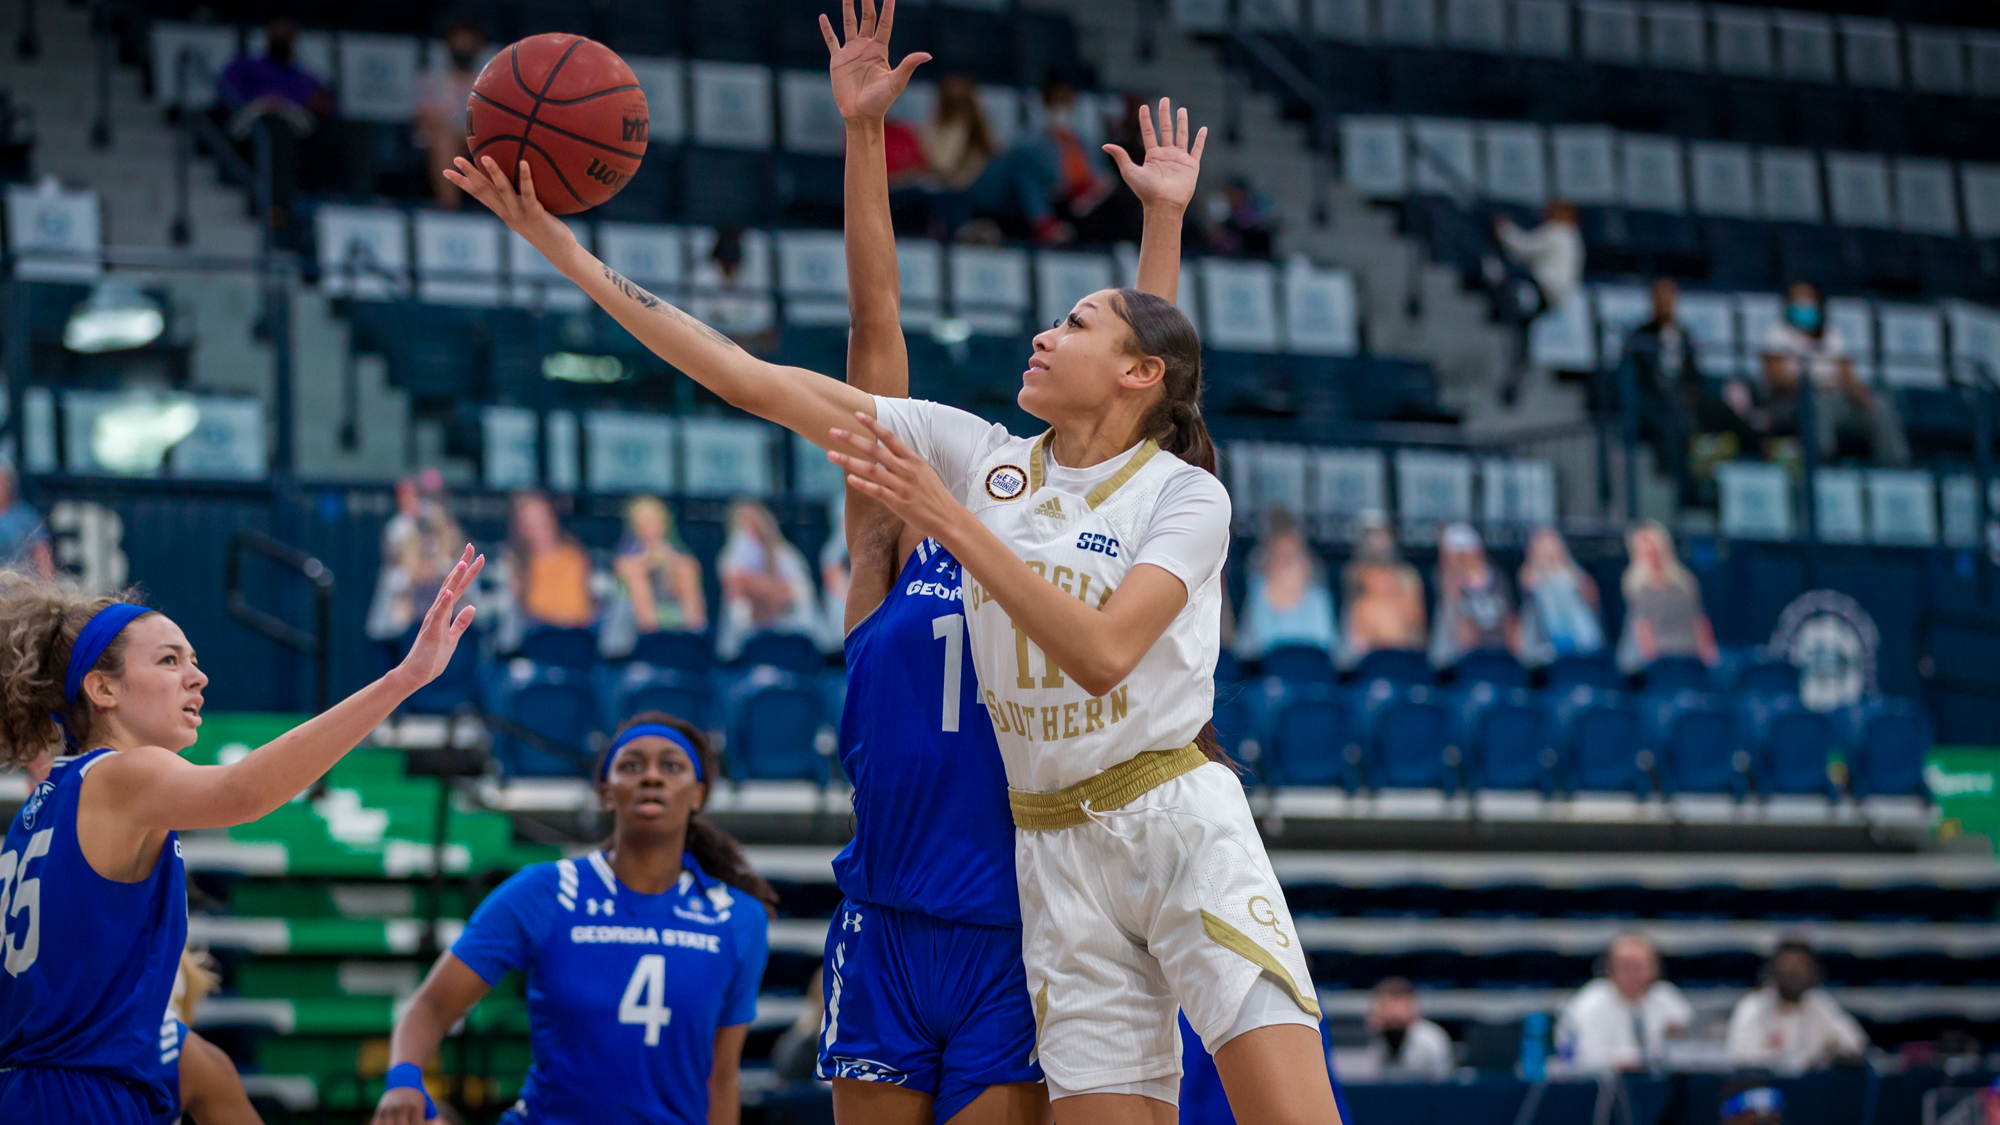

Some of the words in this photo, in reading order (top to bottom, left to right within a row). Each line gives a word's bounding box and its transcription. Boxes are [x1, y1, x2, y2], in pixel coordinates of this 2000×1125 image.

[992, 477, 1016, 493] CHANGE
[1033, 507, 1066, 520] adidas
[1076, 532, 1120, 558] SBC
[1010, 620, 1065, 689] 11
[571, 925, 660, 945] GEORGIA
[661, 928, 721, 953] STATE
[617, 953, 672, 1047] 4
